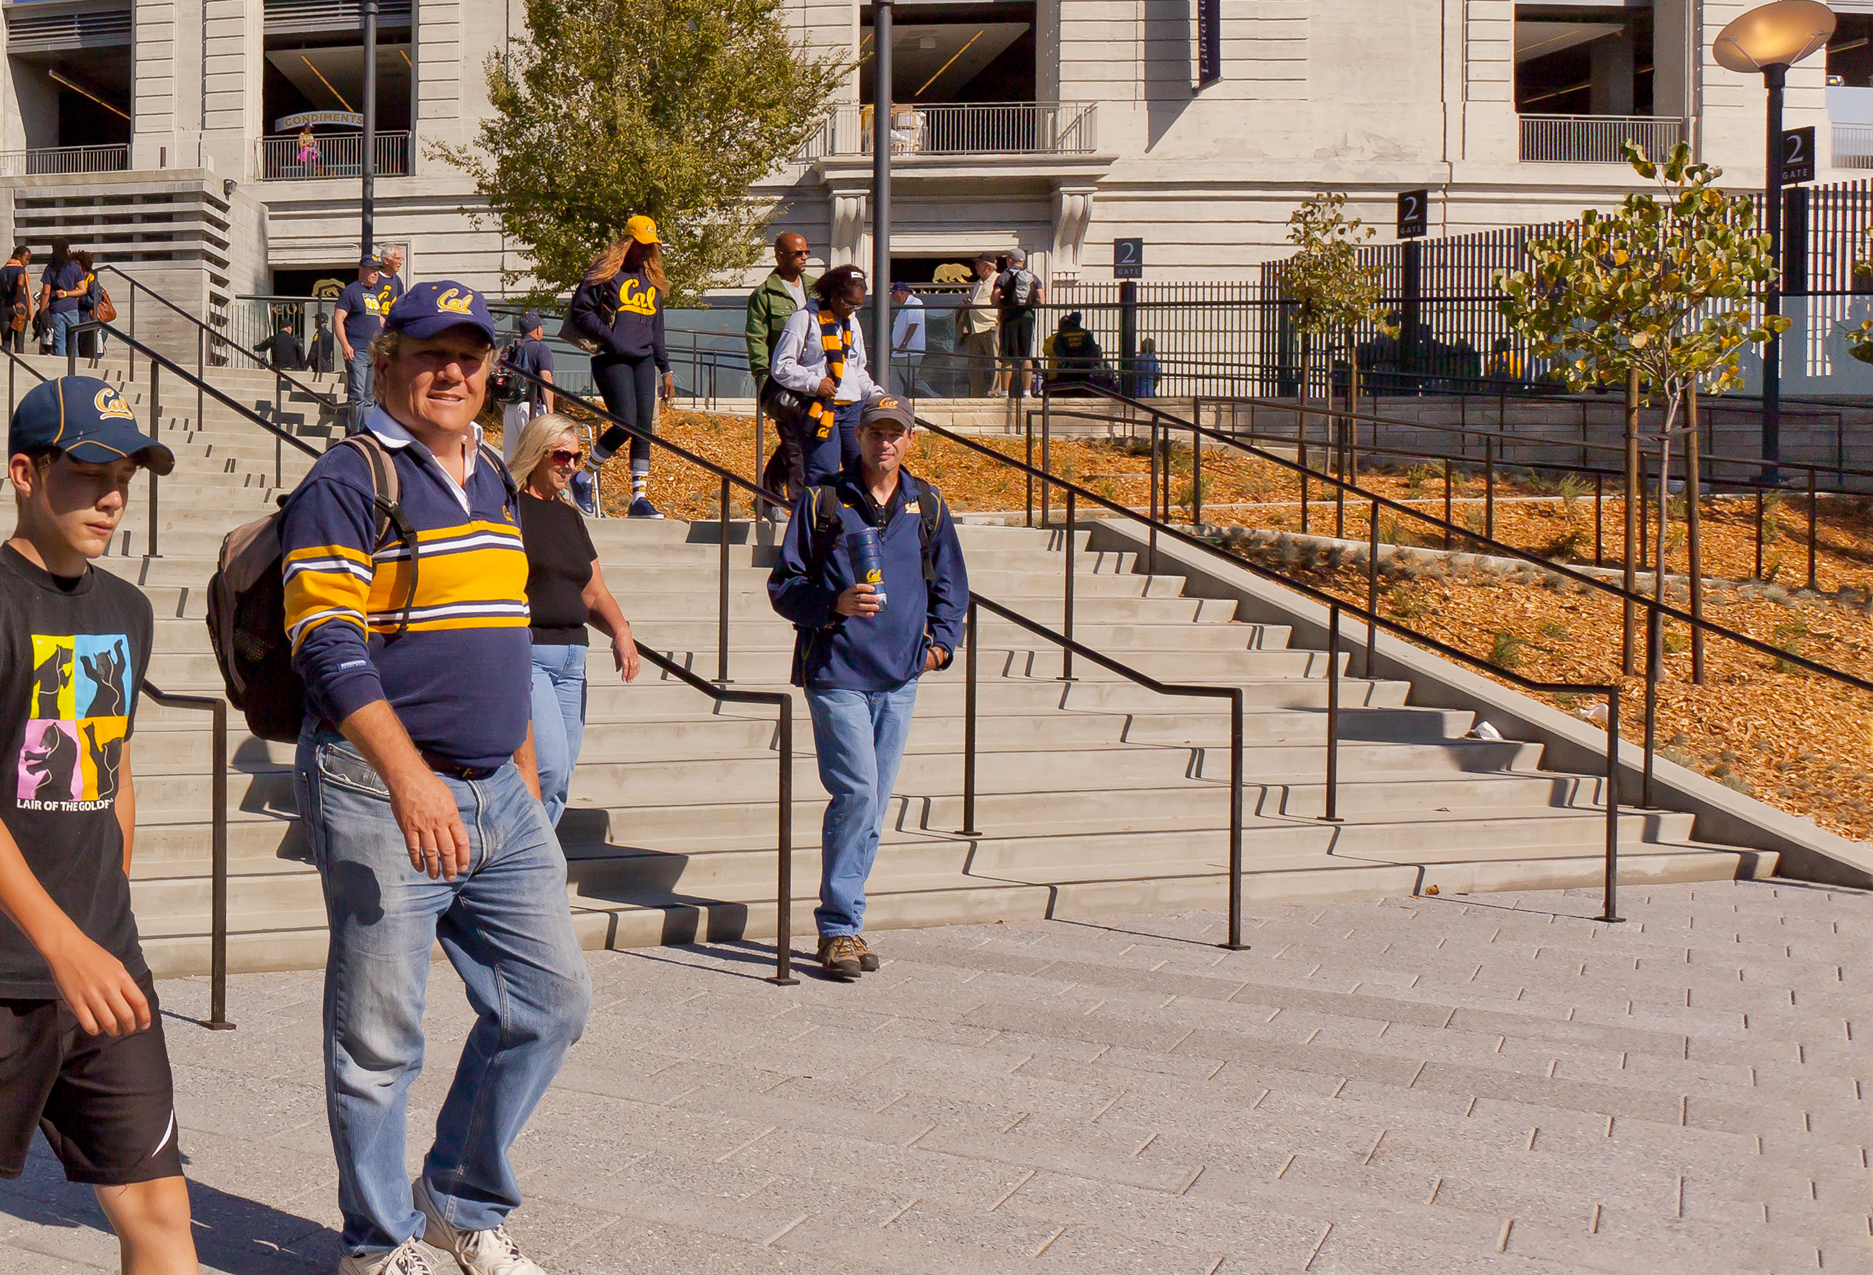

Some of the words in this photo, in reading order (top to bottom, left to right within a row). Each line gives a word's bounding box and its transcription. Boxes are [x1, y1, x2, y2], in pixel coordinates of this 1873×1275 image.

[285, 112, 363, 127] CONDIMENTS
[1786, 134, 1804, 164] 2
[1782, 168, 1808, 180] GATE
[1403, 196, 1419, 221] 2
[1399, 225, 1422, 235] GATE
[1120, 242, 1137, 264] 2
[436, 288, 473, 315] Cal
[619, 278, 657, 316] Cal
[94, 388, 134, 420] Cal
[866, 568, 882, 583] Cal
[17, 798, 42, 810] LAIR
[43, 801, 59, 811] OF
[60, 801, 78, 811] THE
